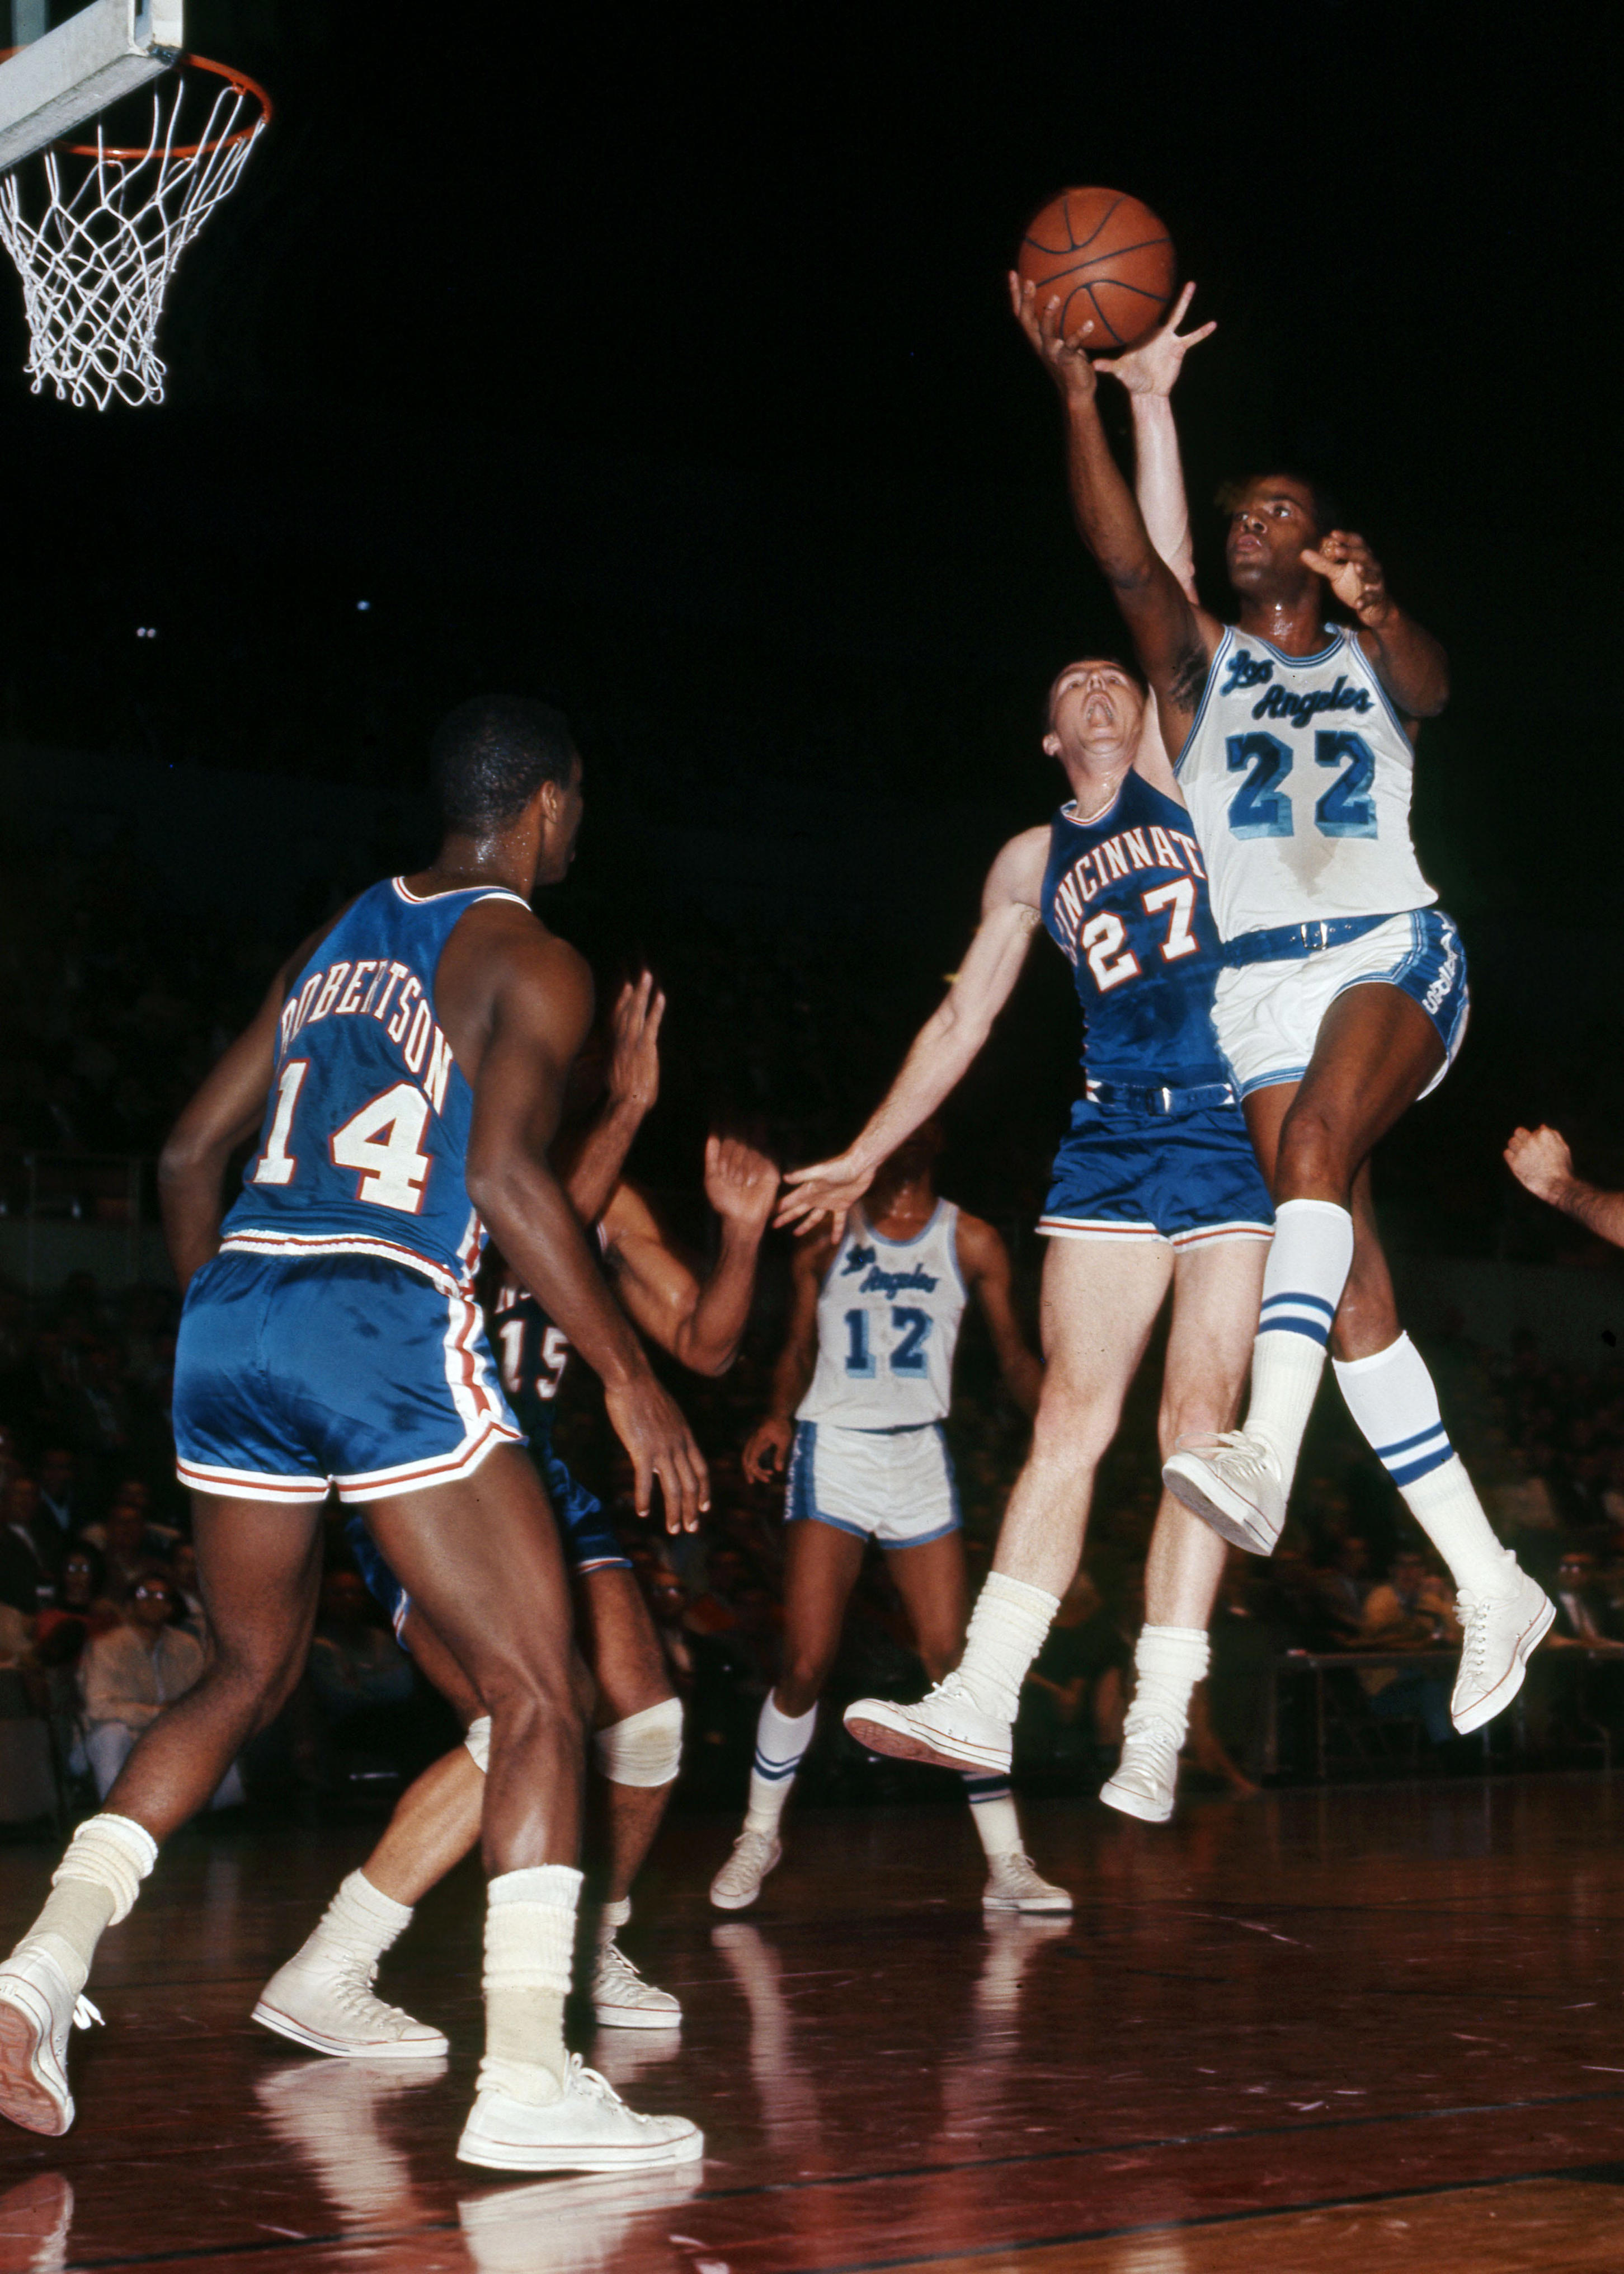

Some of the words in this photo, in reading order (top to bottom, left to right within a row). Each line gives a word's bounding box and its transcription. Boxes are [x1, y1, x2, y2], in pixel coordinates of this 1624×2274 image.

[1220, 650, 1275, 697] Los
[1252, 675, 1374, 729] Angeles
[1225, 730, 1378, 840] 22
[1053, 826, 1208, 967] INCINNAT
[1080, 874, 1201, 994] 27
[246, 1058, 435, 1215] 14
[859, 1262, 940, 1300] Angeles
[498, 1318, 569, 1401] 15
[844, 1304, 933, 1379] 12
